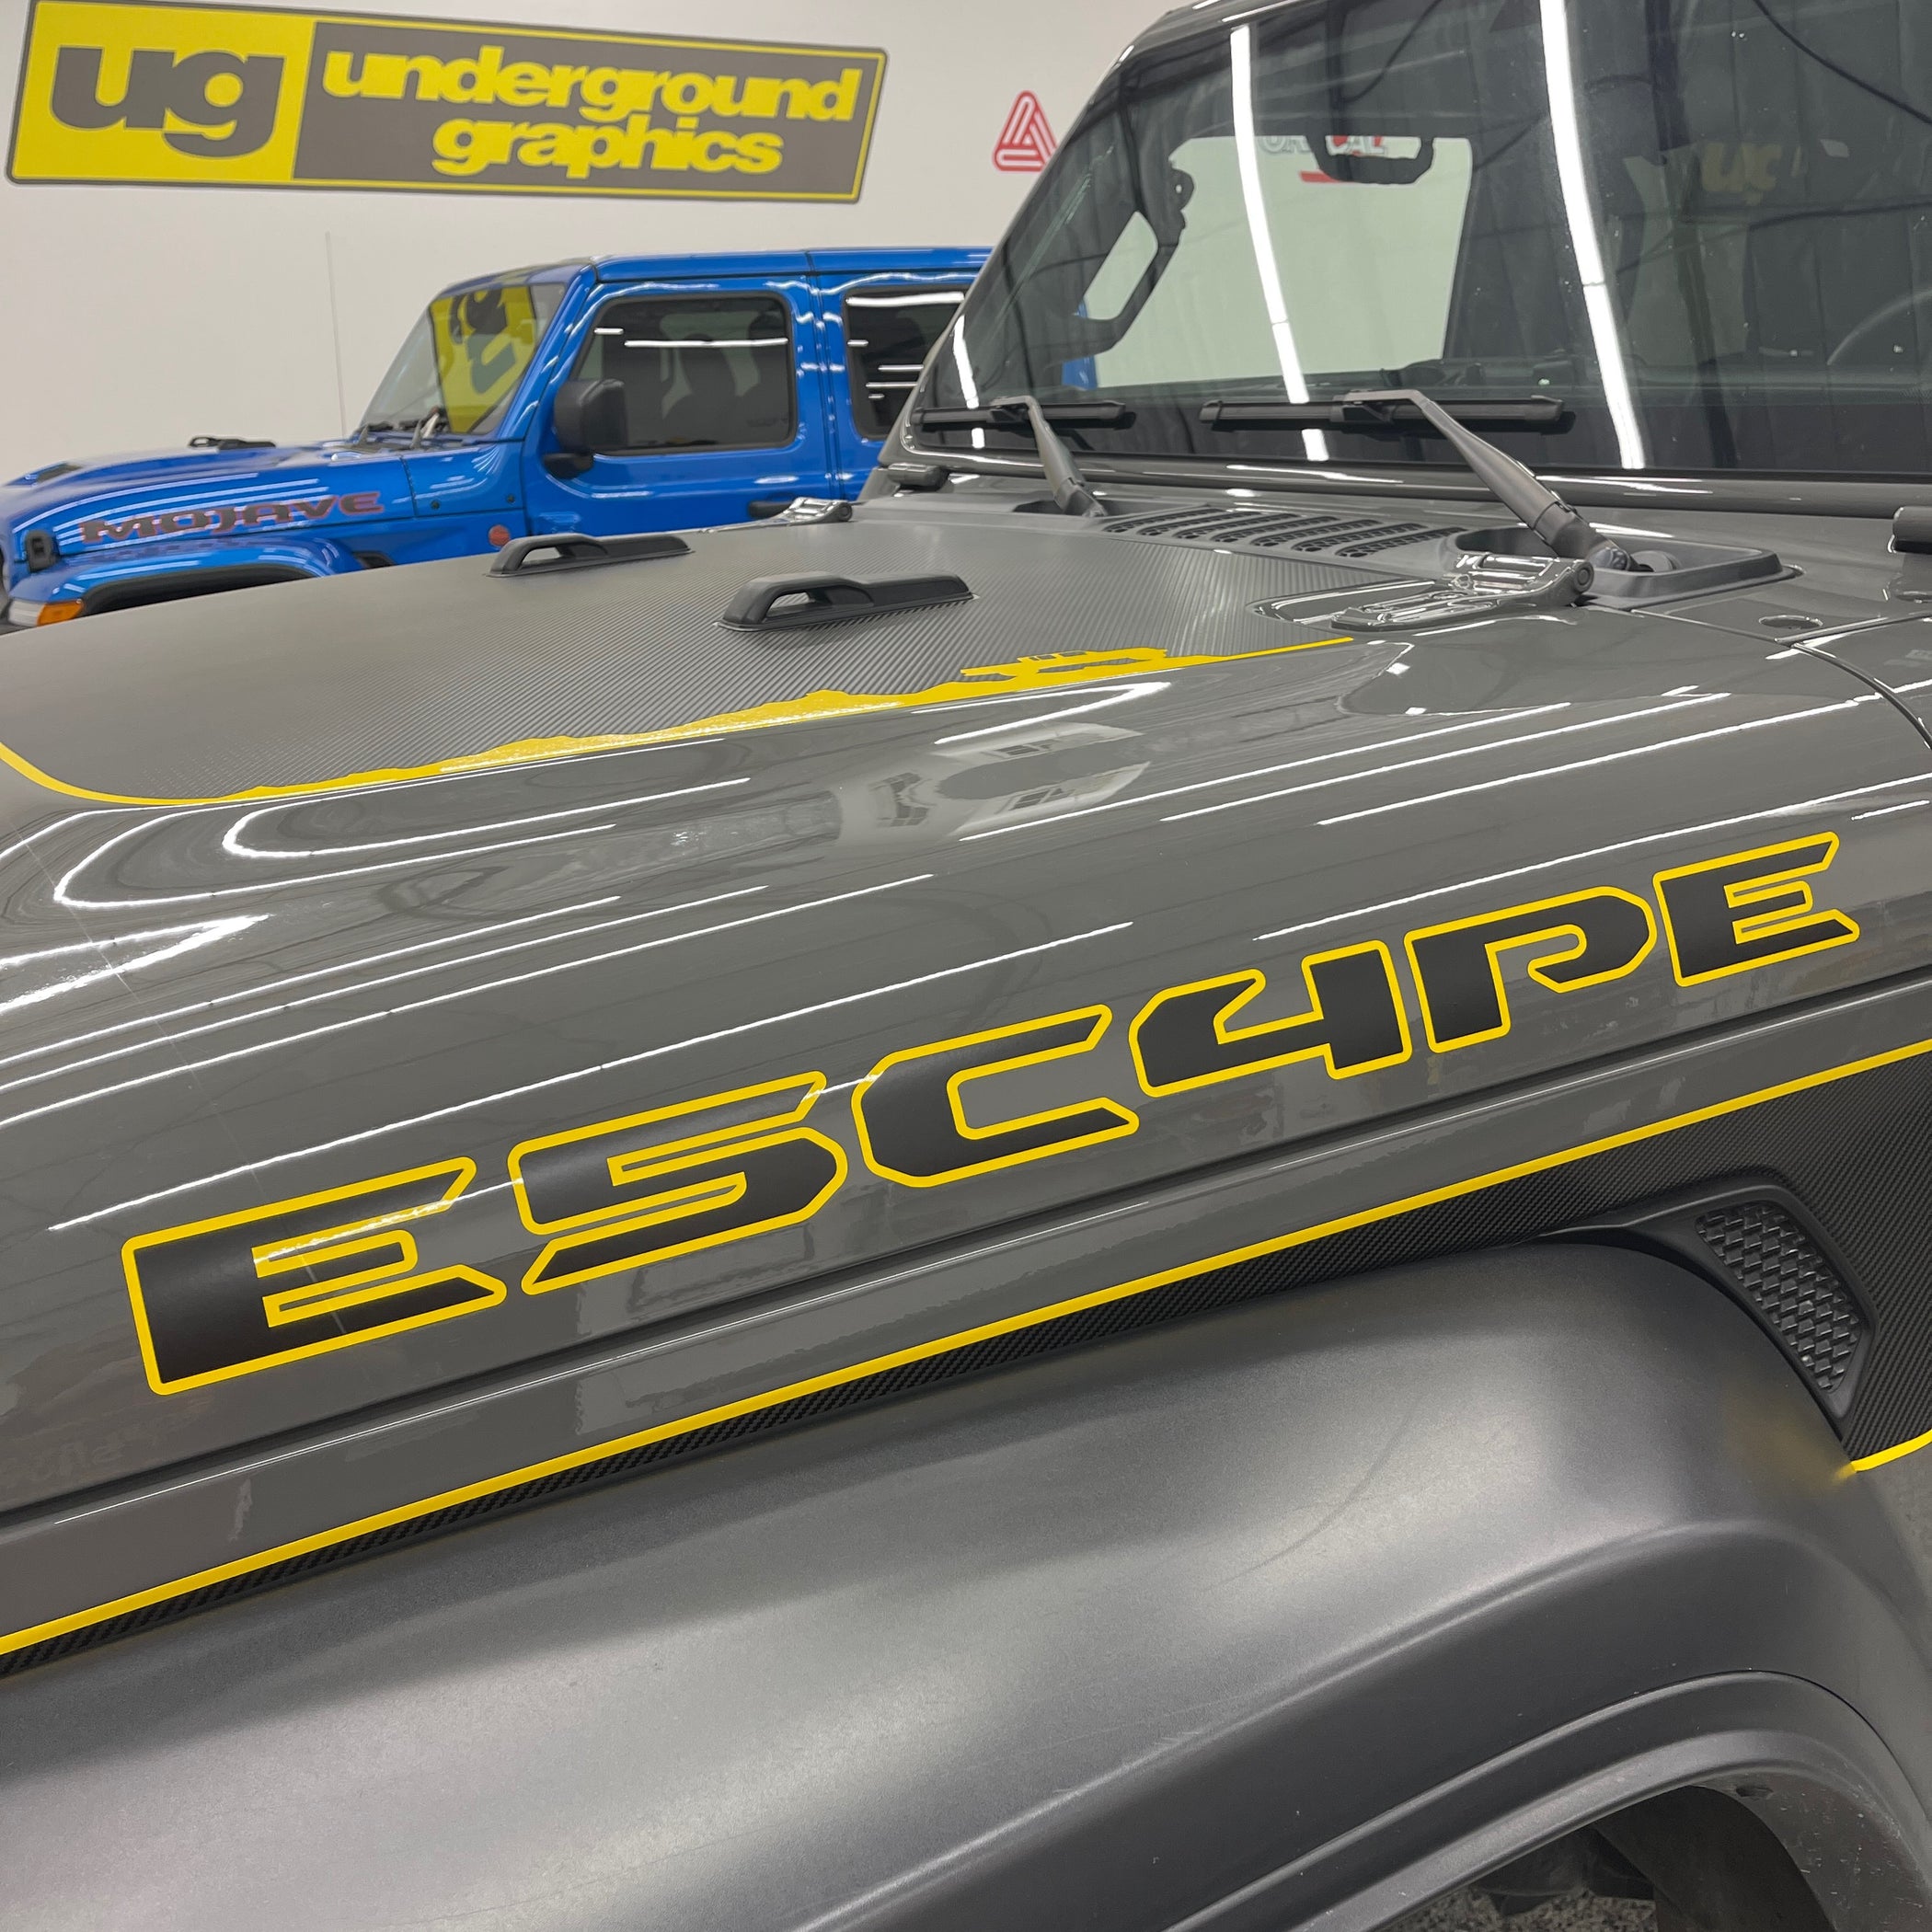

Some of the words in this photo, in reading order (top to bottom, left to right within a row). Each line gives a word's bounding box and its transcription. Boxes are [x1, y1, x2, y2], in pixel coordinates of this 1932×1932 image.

[51, 46, 285, 158] ug
[323, 44, 863, 122] underground
[431, 113, 784, 179] graphics
[78, 491, 385, 543] MOJAVE
